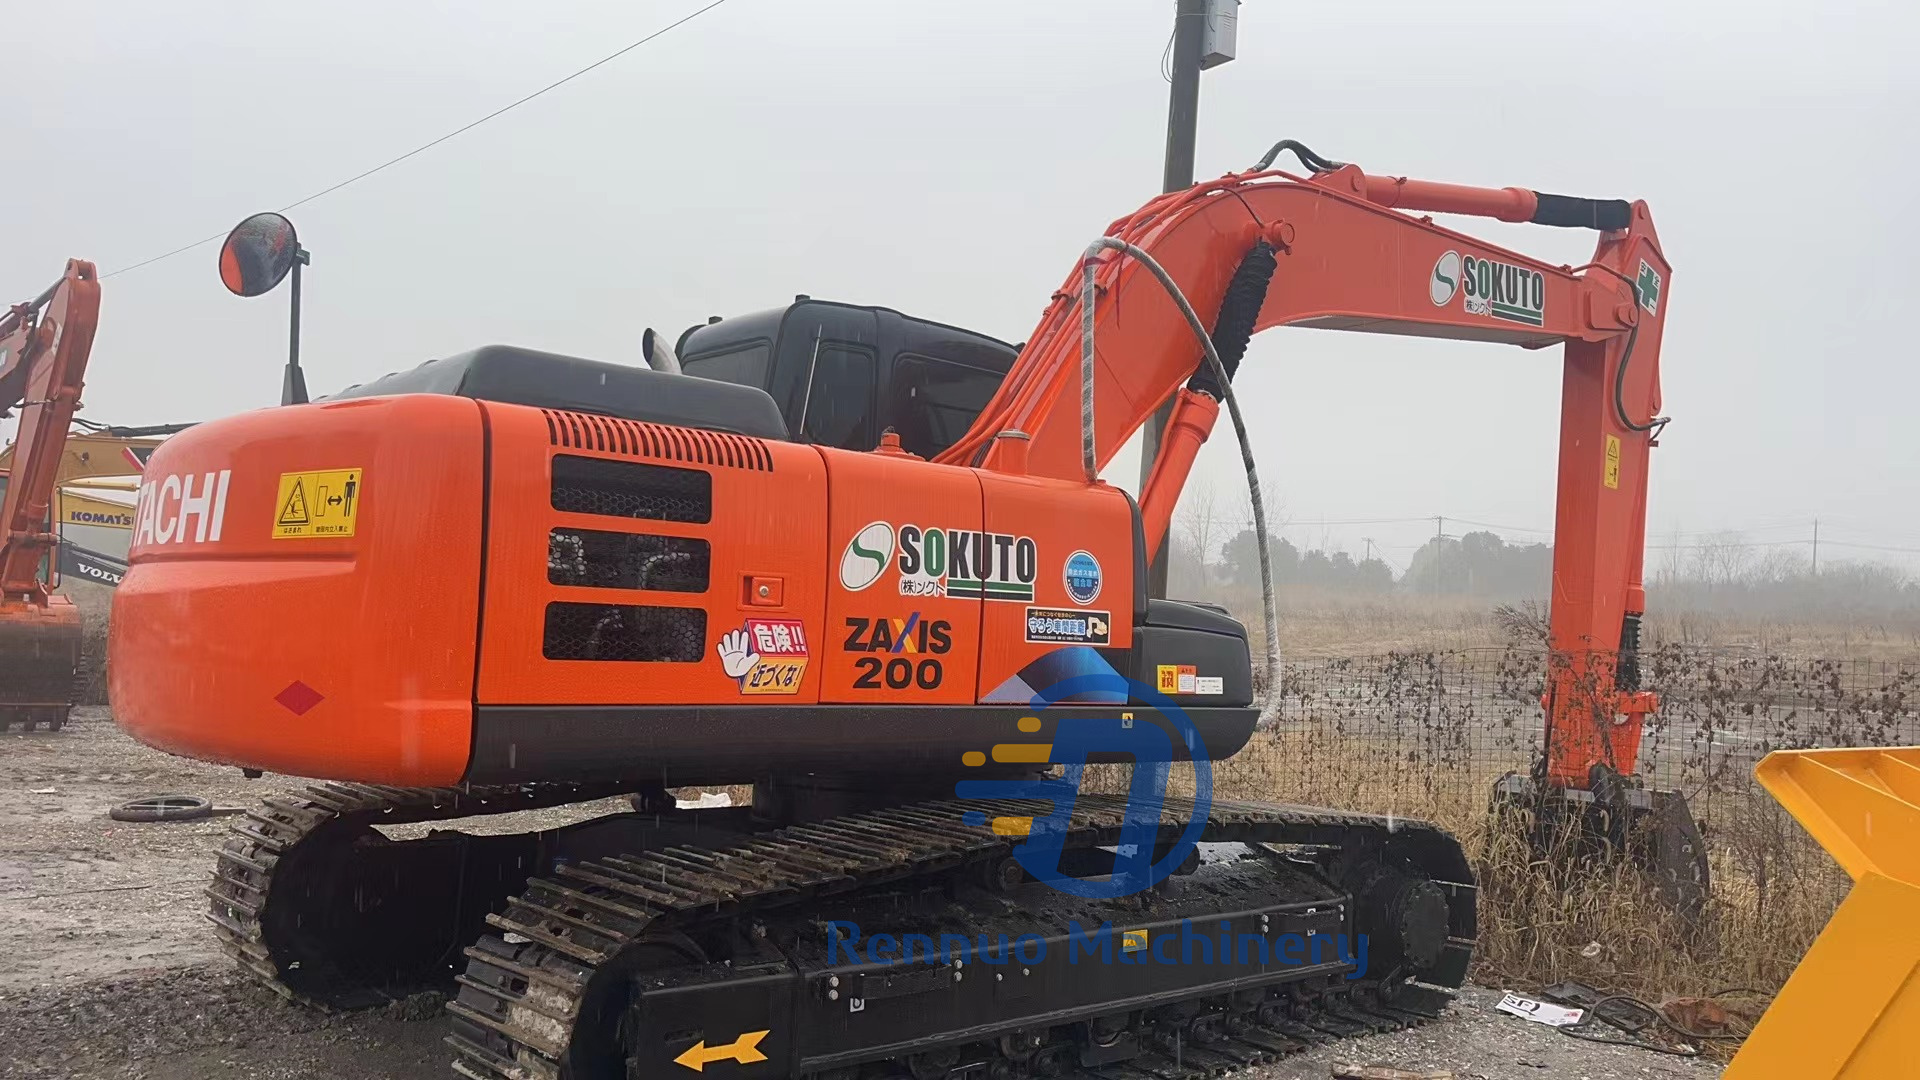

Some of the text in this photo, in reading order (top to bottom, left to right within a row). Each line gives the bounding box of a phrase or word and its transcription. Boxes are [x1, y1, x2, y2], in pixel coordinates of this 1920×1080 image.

[1464, 255, 1544, 311] SOKUTO
[71, 511, 134, 526] KOMATS
[132, 470, 231, 547] TACHI
[77, 563, 124, 584] VOLV
[900, 526, 1036, 583] SOKUTO
[844, 612, 952, 654] ZAXIS
[852, 657, 943, 690] 200
